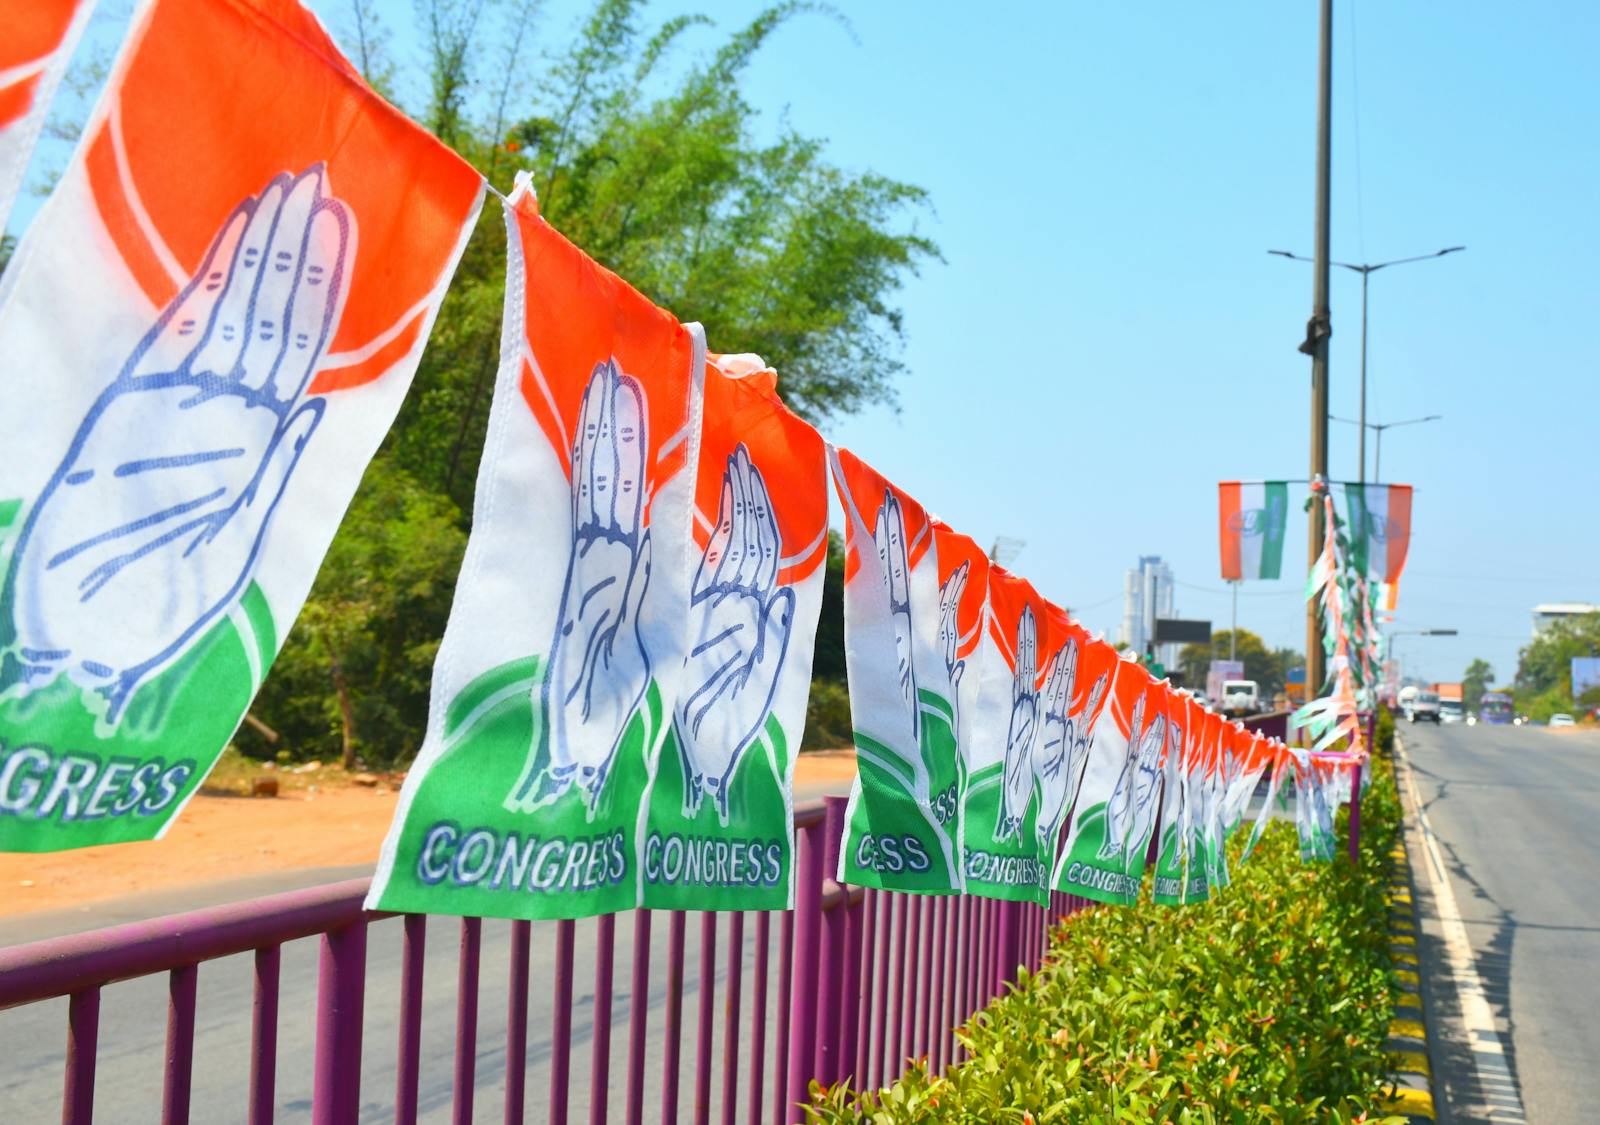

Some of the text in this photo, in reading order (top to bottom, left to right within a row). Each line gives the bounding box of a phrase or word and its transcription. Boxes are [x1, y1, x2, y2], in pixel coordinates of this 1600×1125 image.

[0, 744, 194, 819] GRESS
[417, 823, 626, 891] CONGRESS
[644, 832, 784, 887] CONGRESS
[963, 847, 1039, 884] ONGRESS
